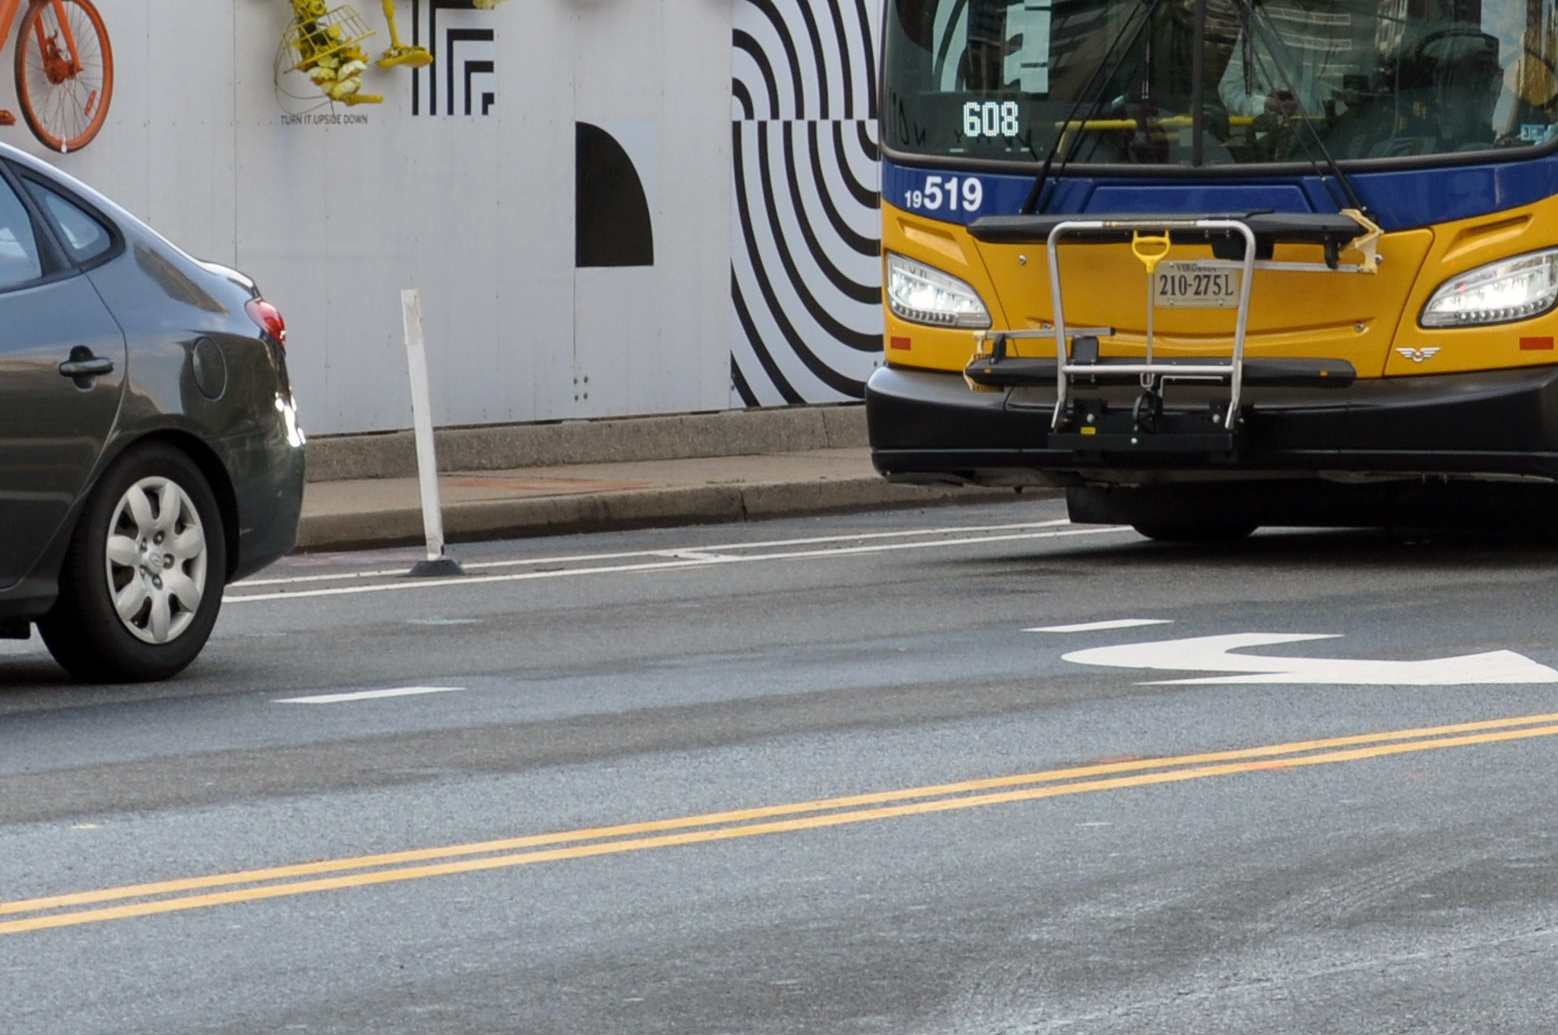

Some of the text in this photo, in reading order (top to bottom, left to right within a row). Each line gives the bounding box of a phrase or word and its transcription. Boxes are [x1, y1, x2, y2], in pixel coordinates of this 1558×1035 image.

[280, 114, 302, 126] TURN
[313, 114, 342, 125] UPSIDE
[343, 114, 368, 125] DOWN
[963, 101, 1019, 137] 608
[1159, 274, 1235, 296] 210-275L
